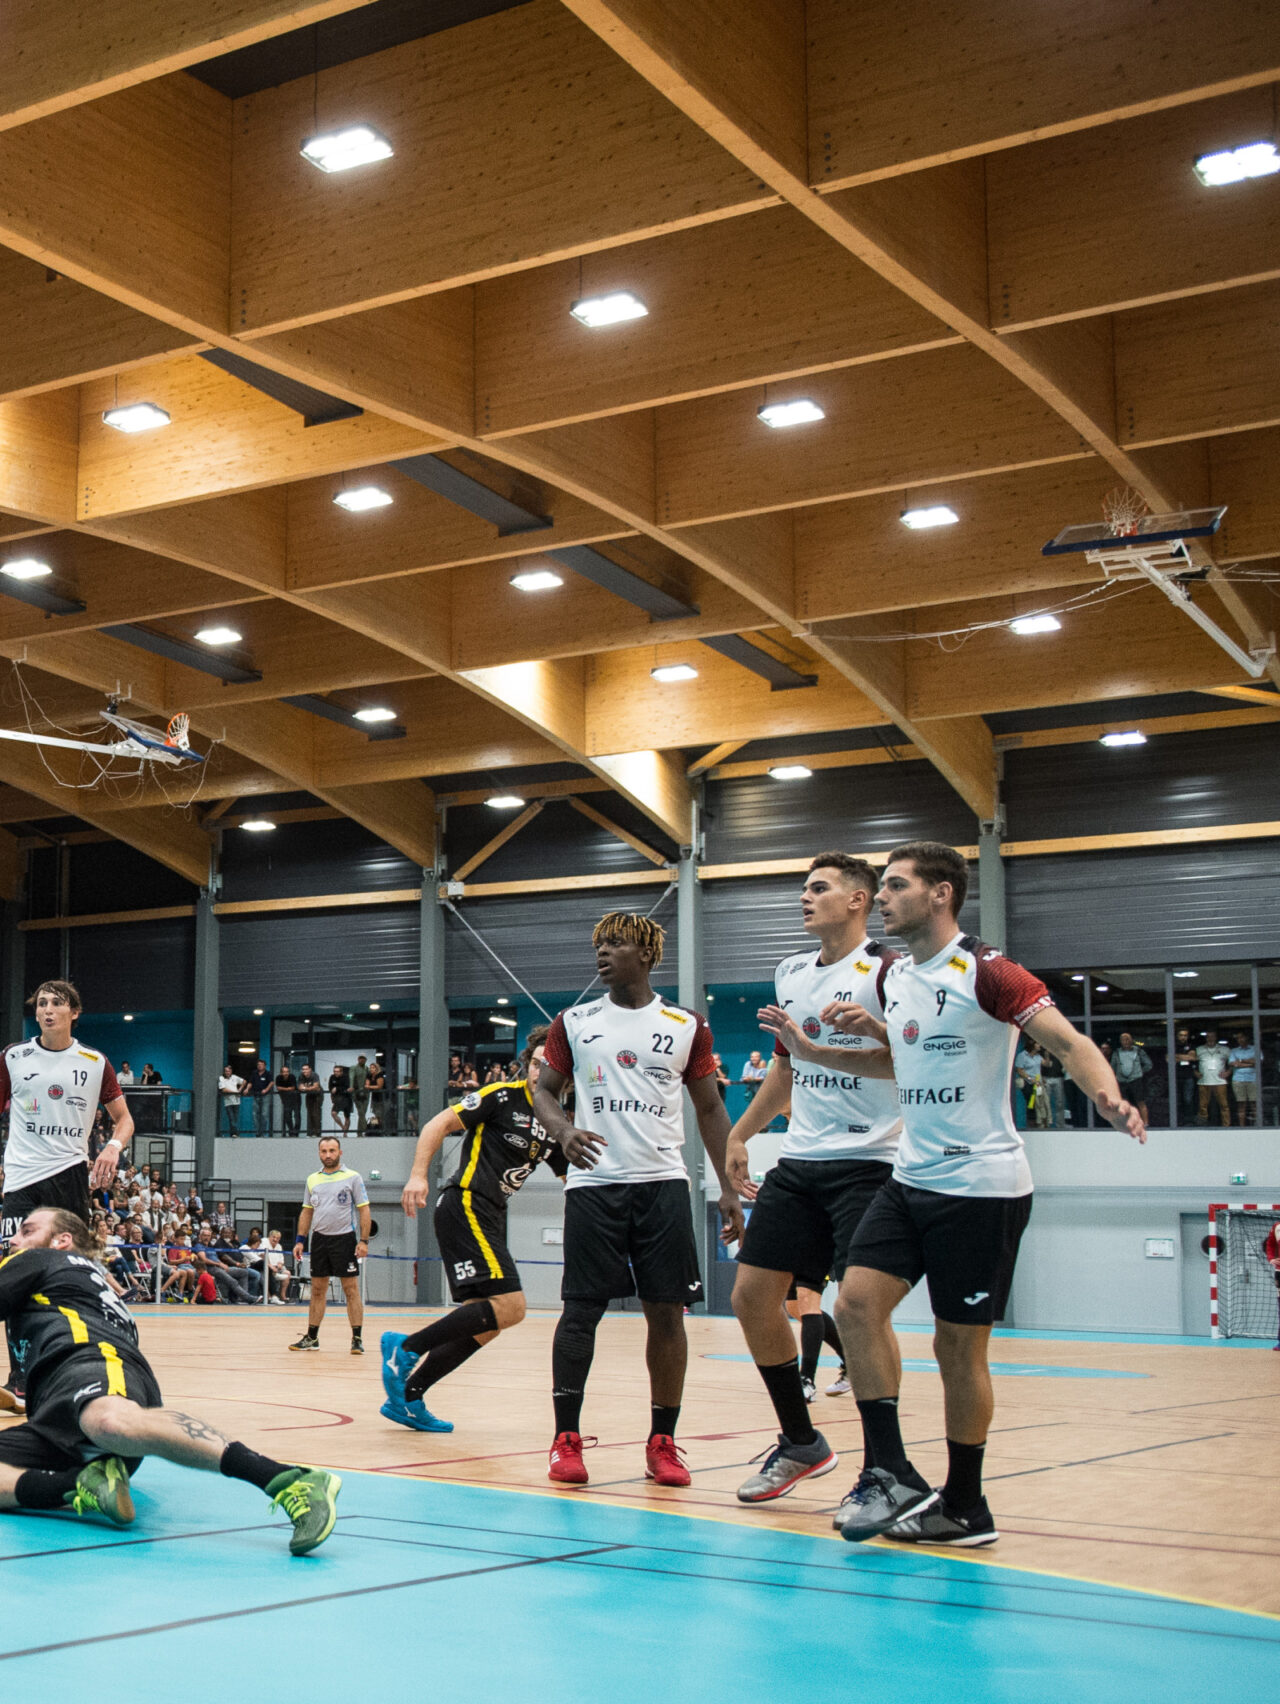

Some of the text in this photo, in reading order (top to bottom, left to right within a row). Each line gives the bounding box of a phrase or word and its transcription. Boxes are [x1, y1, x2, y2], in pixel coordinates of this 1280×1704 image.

[936, 989, 947, 1016] 9
[652, 1033, 674, 1055] 22
[72, 1069, 88, 1087] 19
[899, 1086, 966, 1105] EIFFAGE
[609, 1099, 668, 1118] EIFFAGE
[39, 1125, 84, 1138] EIFFAGE
[531, 1117, 547, 1141] 55
[453, 1260, 477, 1281] 55
